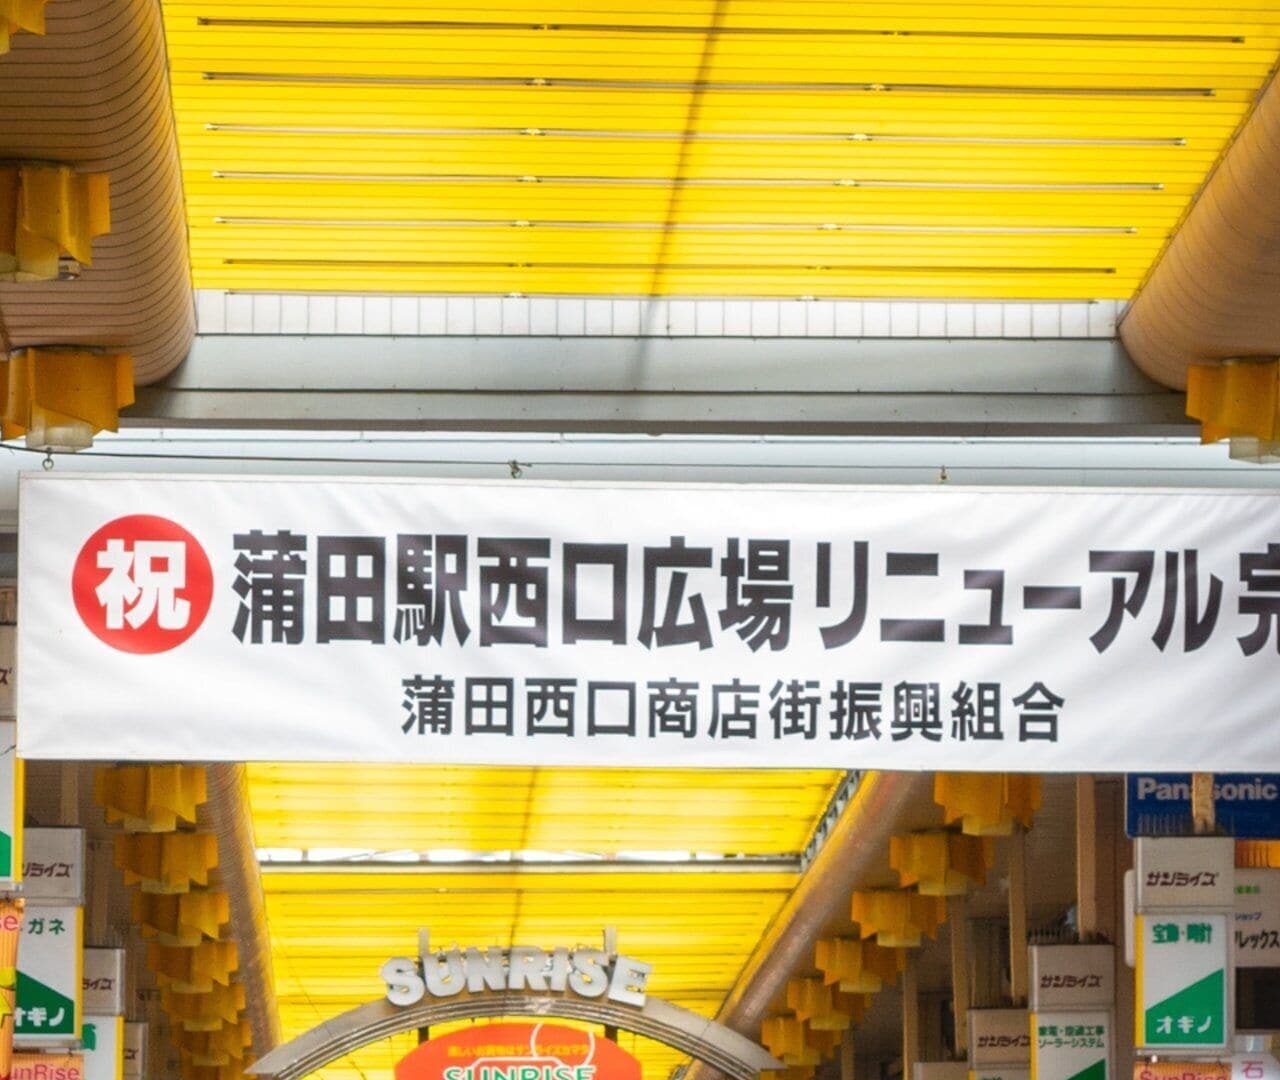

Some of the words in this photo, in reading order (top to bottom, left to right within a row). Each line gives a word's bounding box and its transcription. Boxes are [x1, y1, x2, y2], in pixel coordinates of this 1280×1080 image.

[95, 537, 192, 632] 祝
[400, 673, 1066, 744] 蒲田西口商店街振興組合
[1137, 776, 1279, 801] Pansonic
[1145, 871, 1219, 887] サンライズ
[381, 944, 653, 1008] SUNRISE
[1155, 1014, 1214, 1036] オギノ
